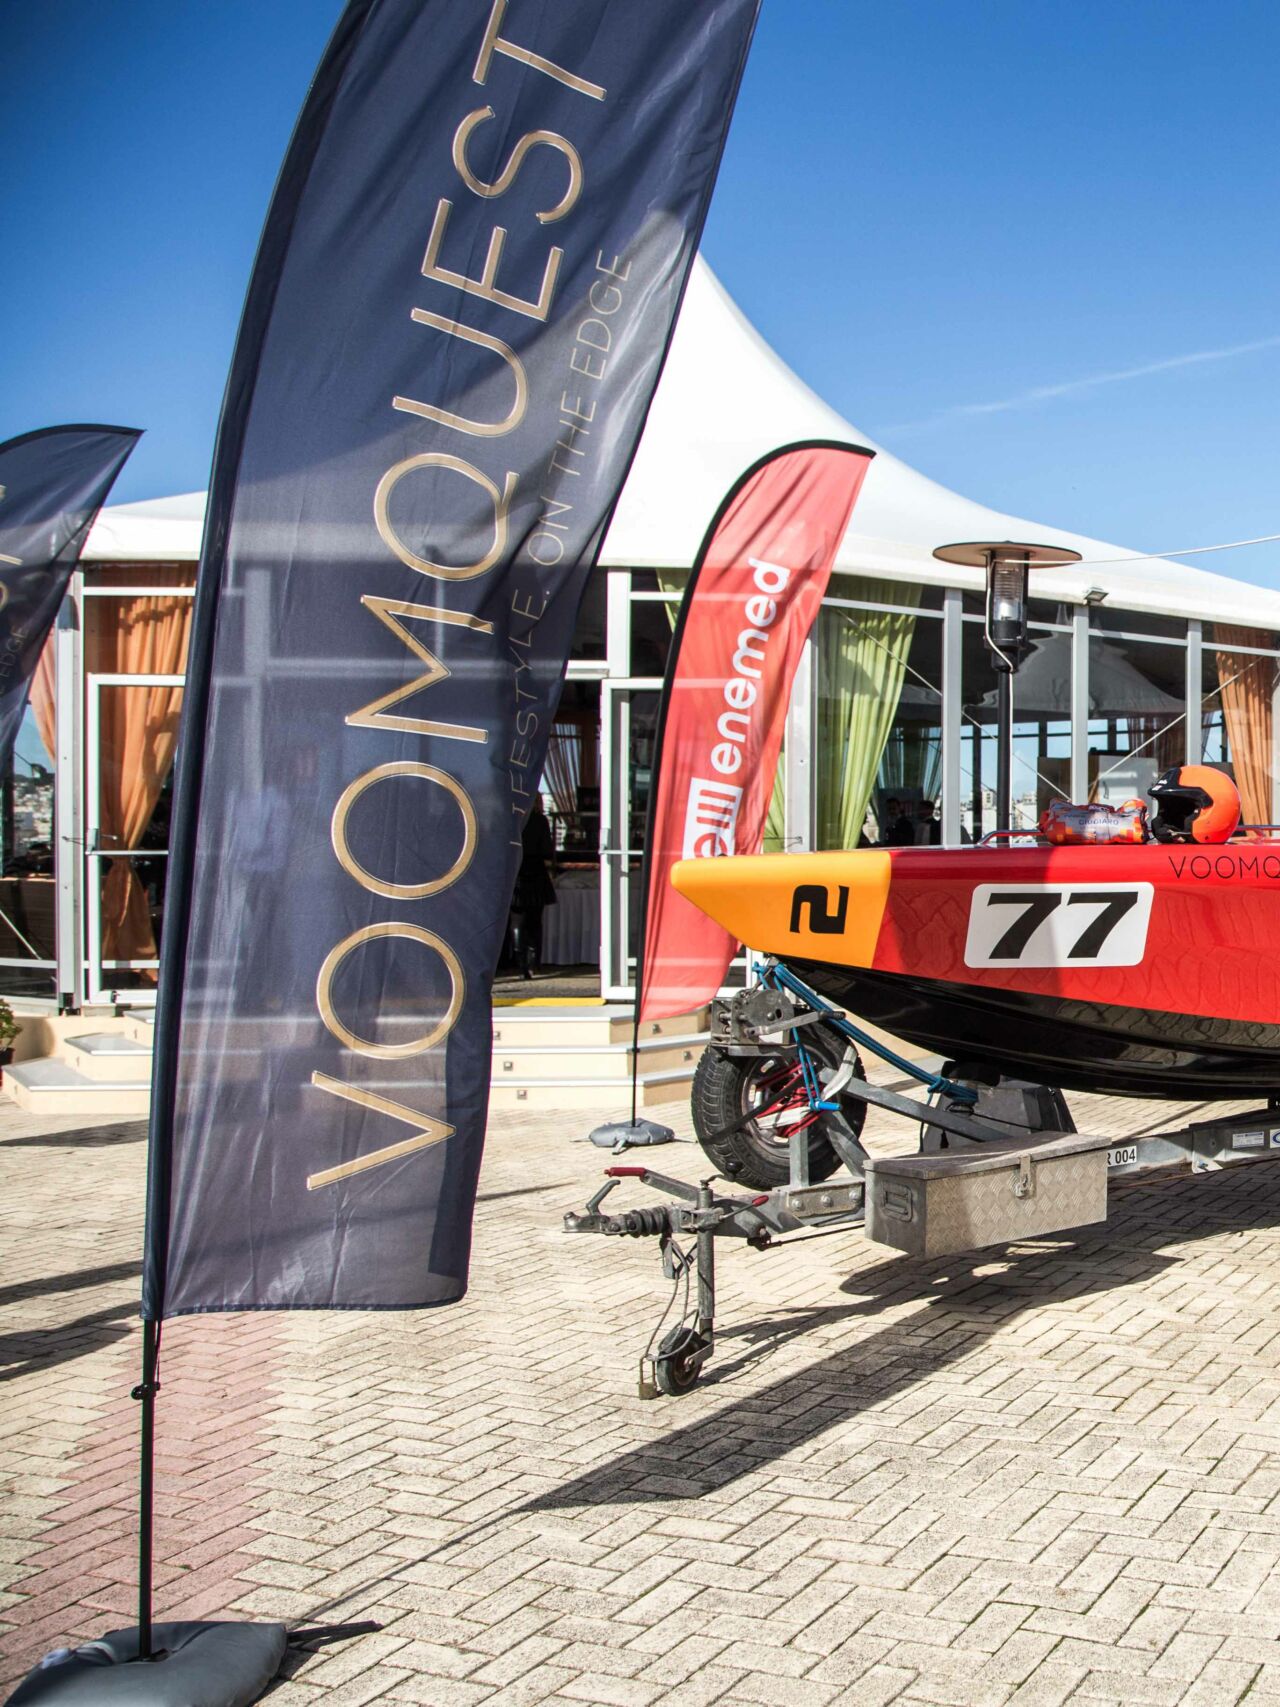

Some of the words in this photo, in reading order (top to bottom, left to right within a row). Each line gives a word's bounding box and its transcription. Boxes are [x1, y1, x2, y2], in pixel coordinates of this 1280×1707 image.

[570, 250, 632, 381] EDGE
[548, 391, 597, 477] THE
[527, 496, 573, 566] ON
[306, 0, 607, 1191] VOOMQUEST
[710, 557, 791, 775] enemed
[986, 890, 1139, 960] 77
[1115, 1148, 1136, 1164] 004
